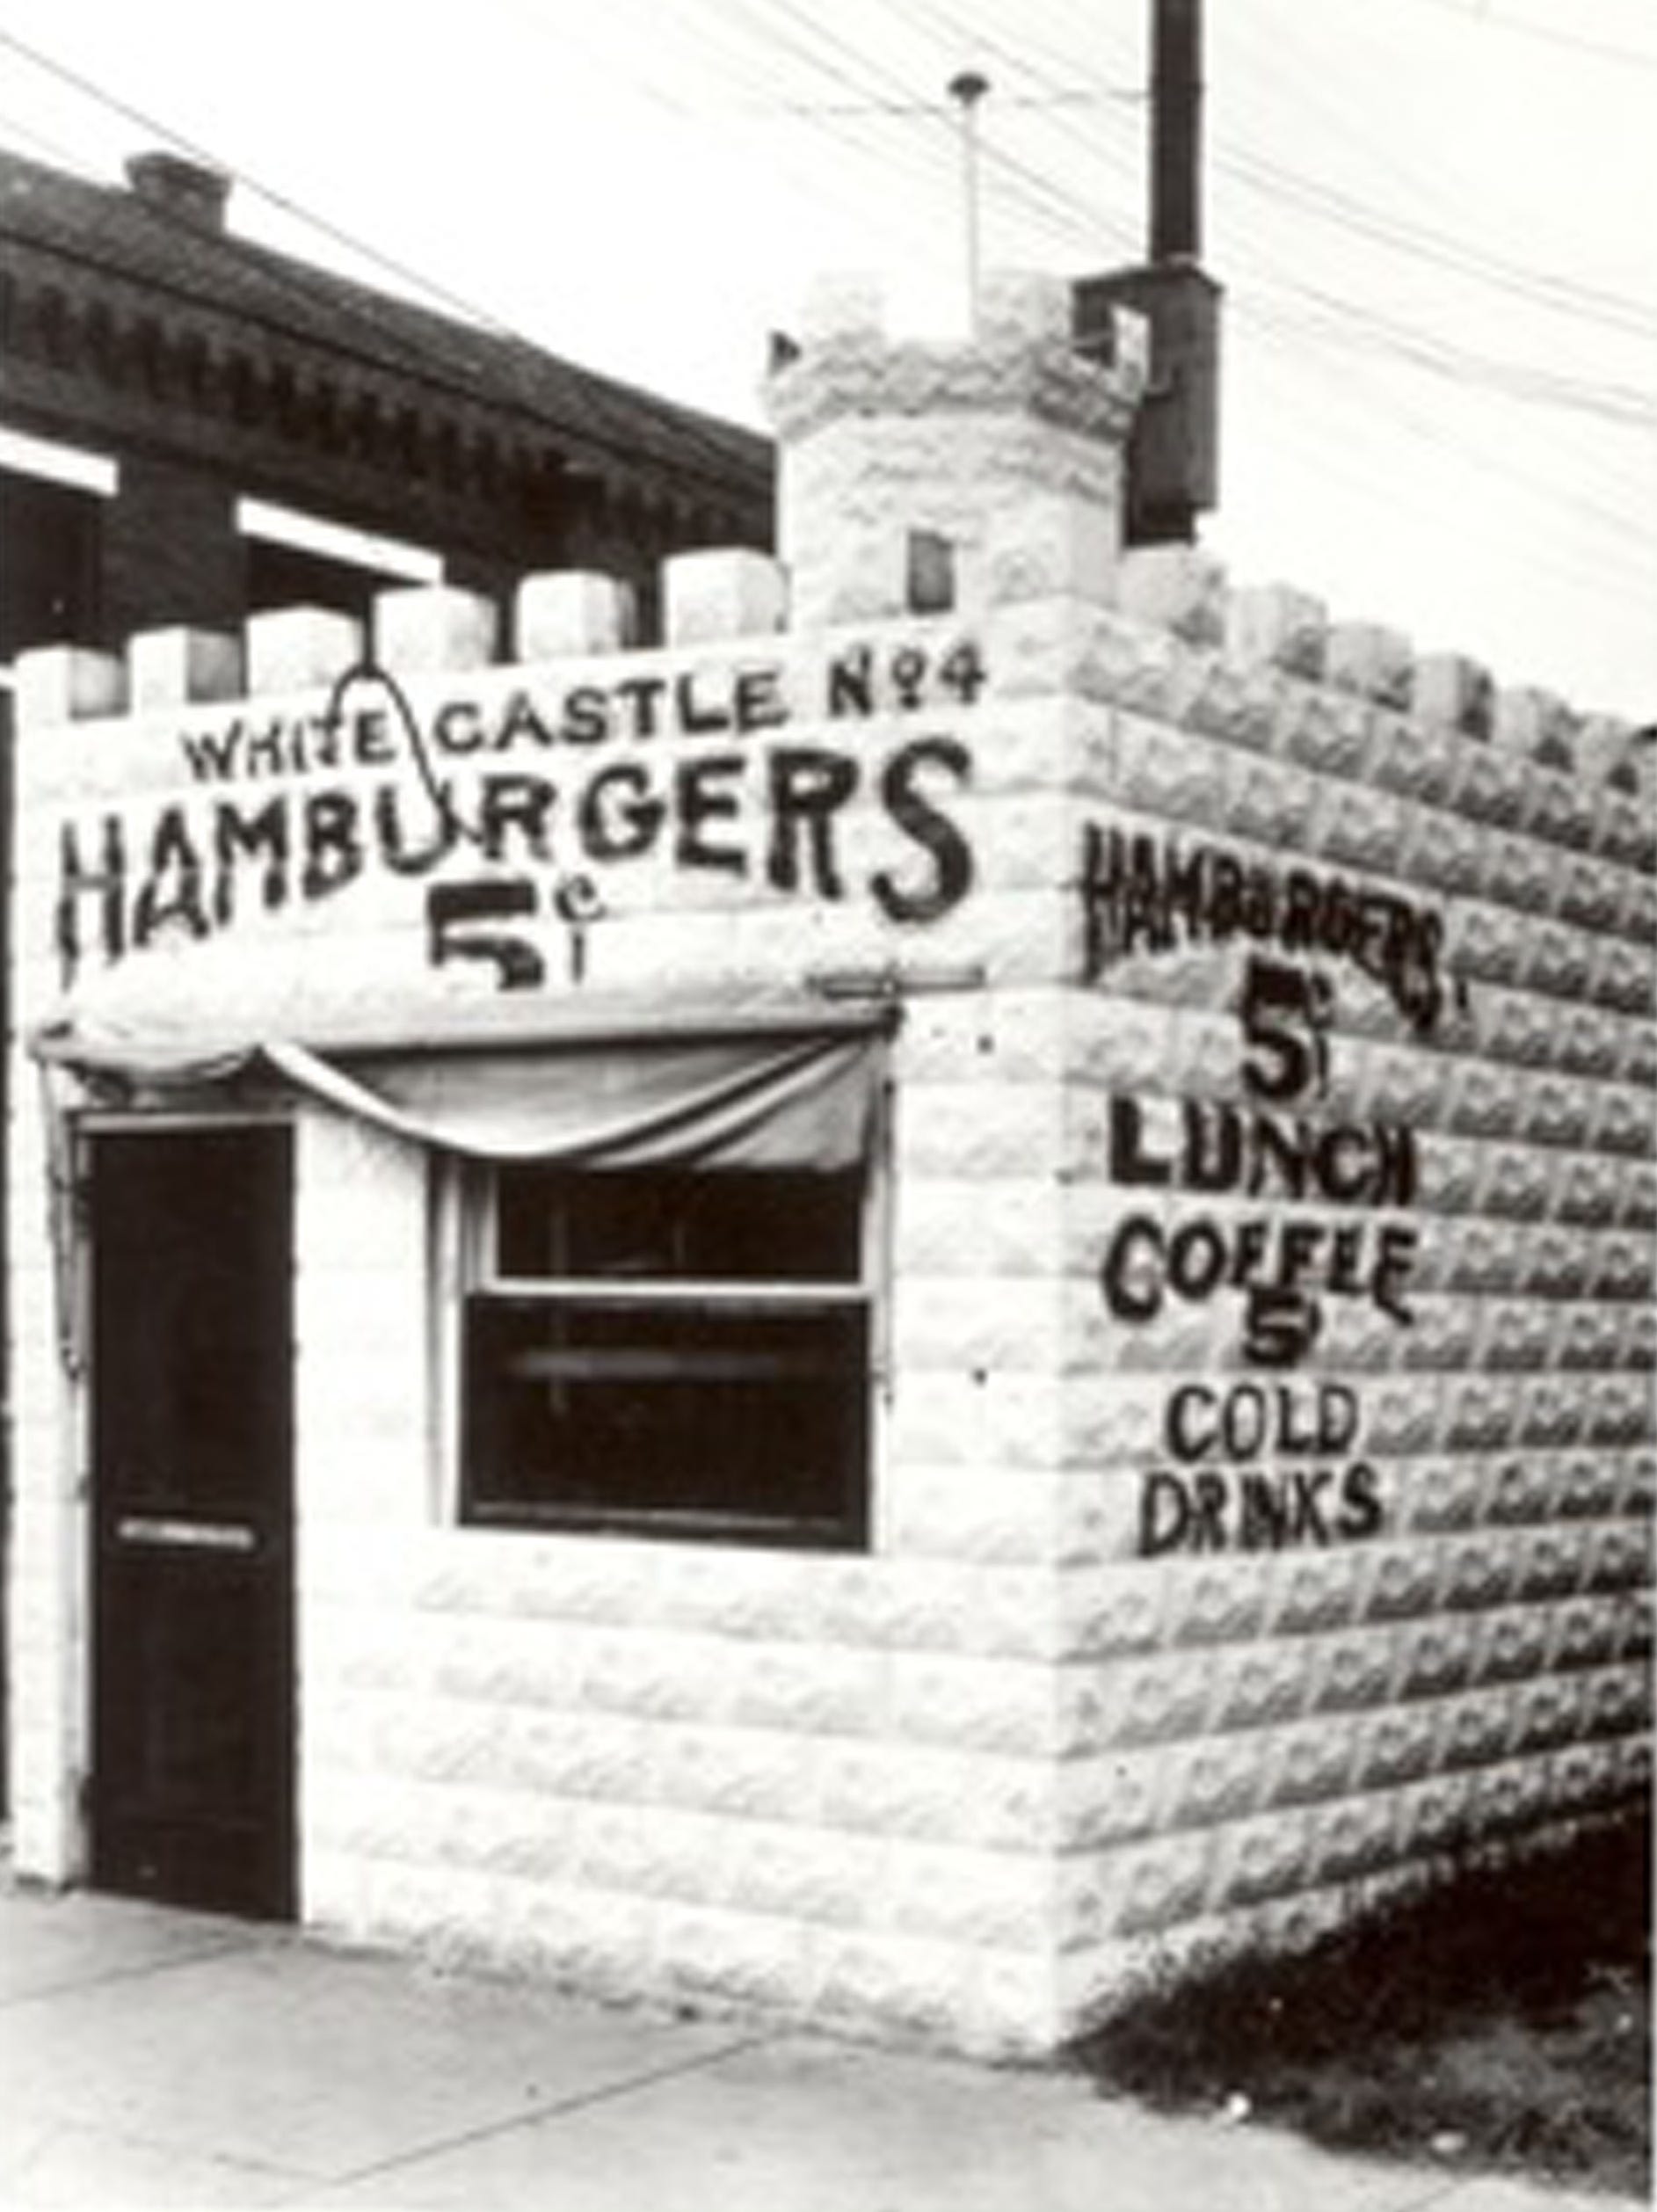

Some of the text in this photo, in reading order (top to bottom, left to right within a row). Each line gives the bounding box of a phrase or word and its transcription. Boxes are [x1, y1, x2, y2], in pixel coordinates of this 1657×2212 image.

[181, 714, 395, 781] WHITE
[432, 664, 788, 756] CASTLE
[56, 737, 974, 993] HAMBURGERS
[1110, 1094, 1418, 1208] LUNCH
[1166, 1384, 1358, 1462] COLD
[1139, 1463, 1383, 1558] DRINKS
